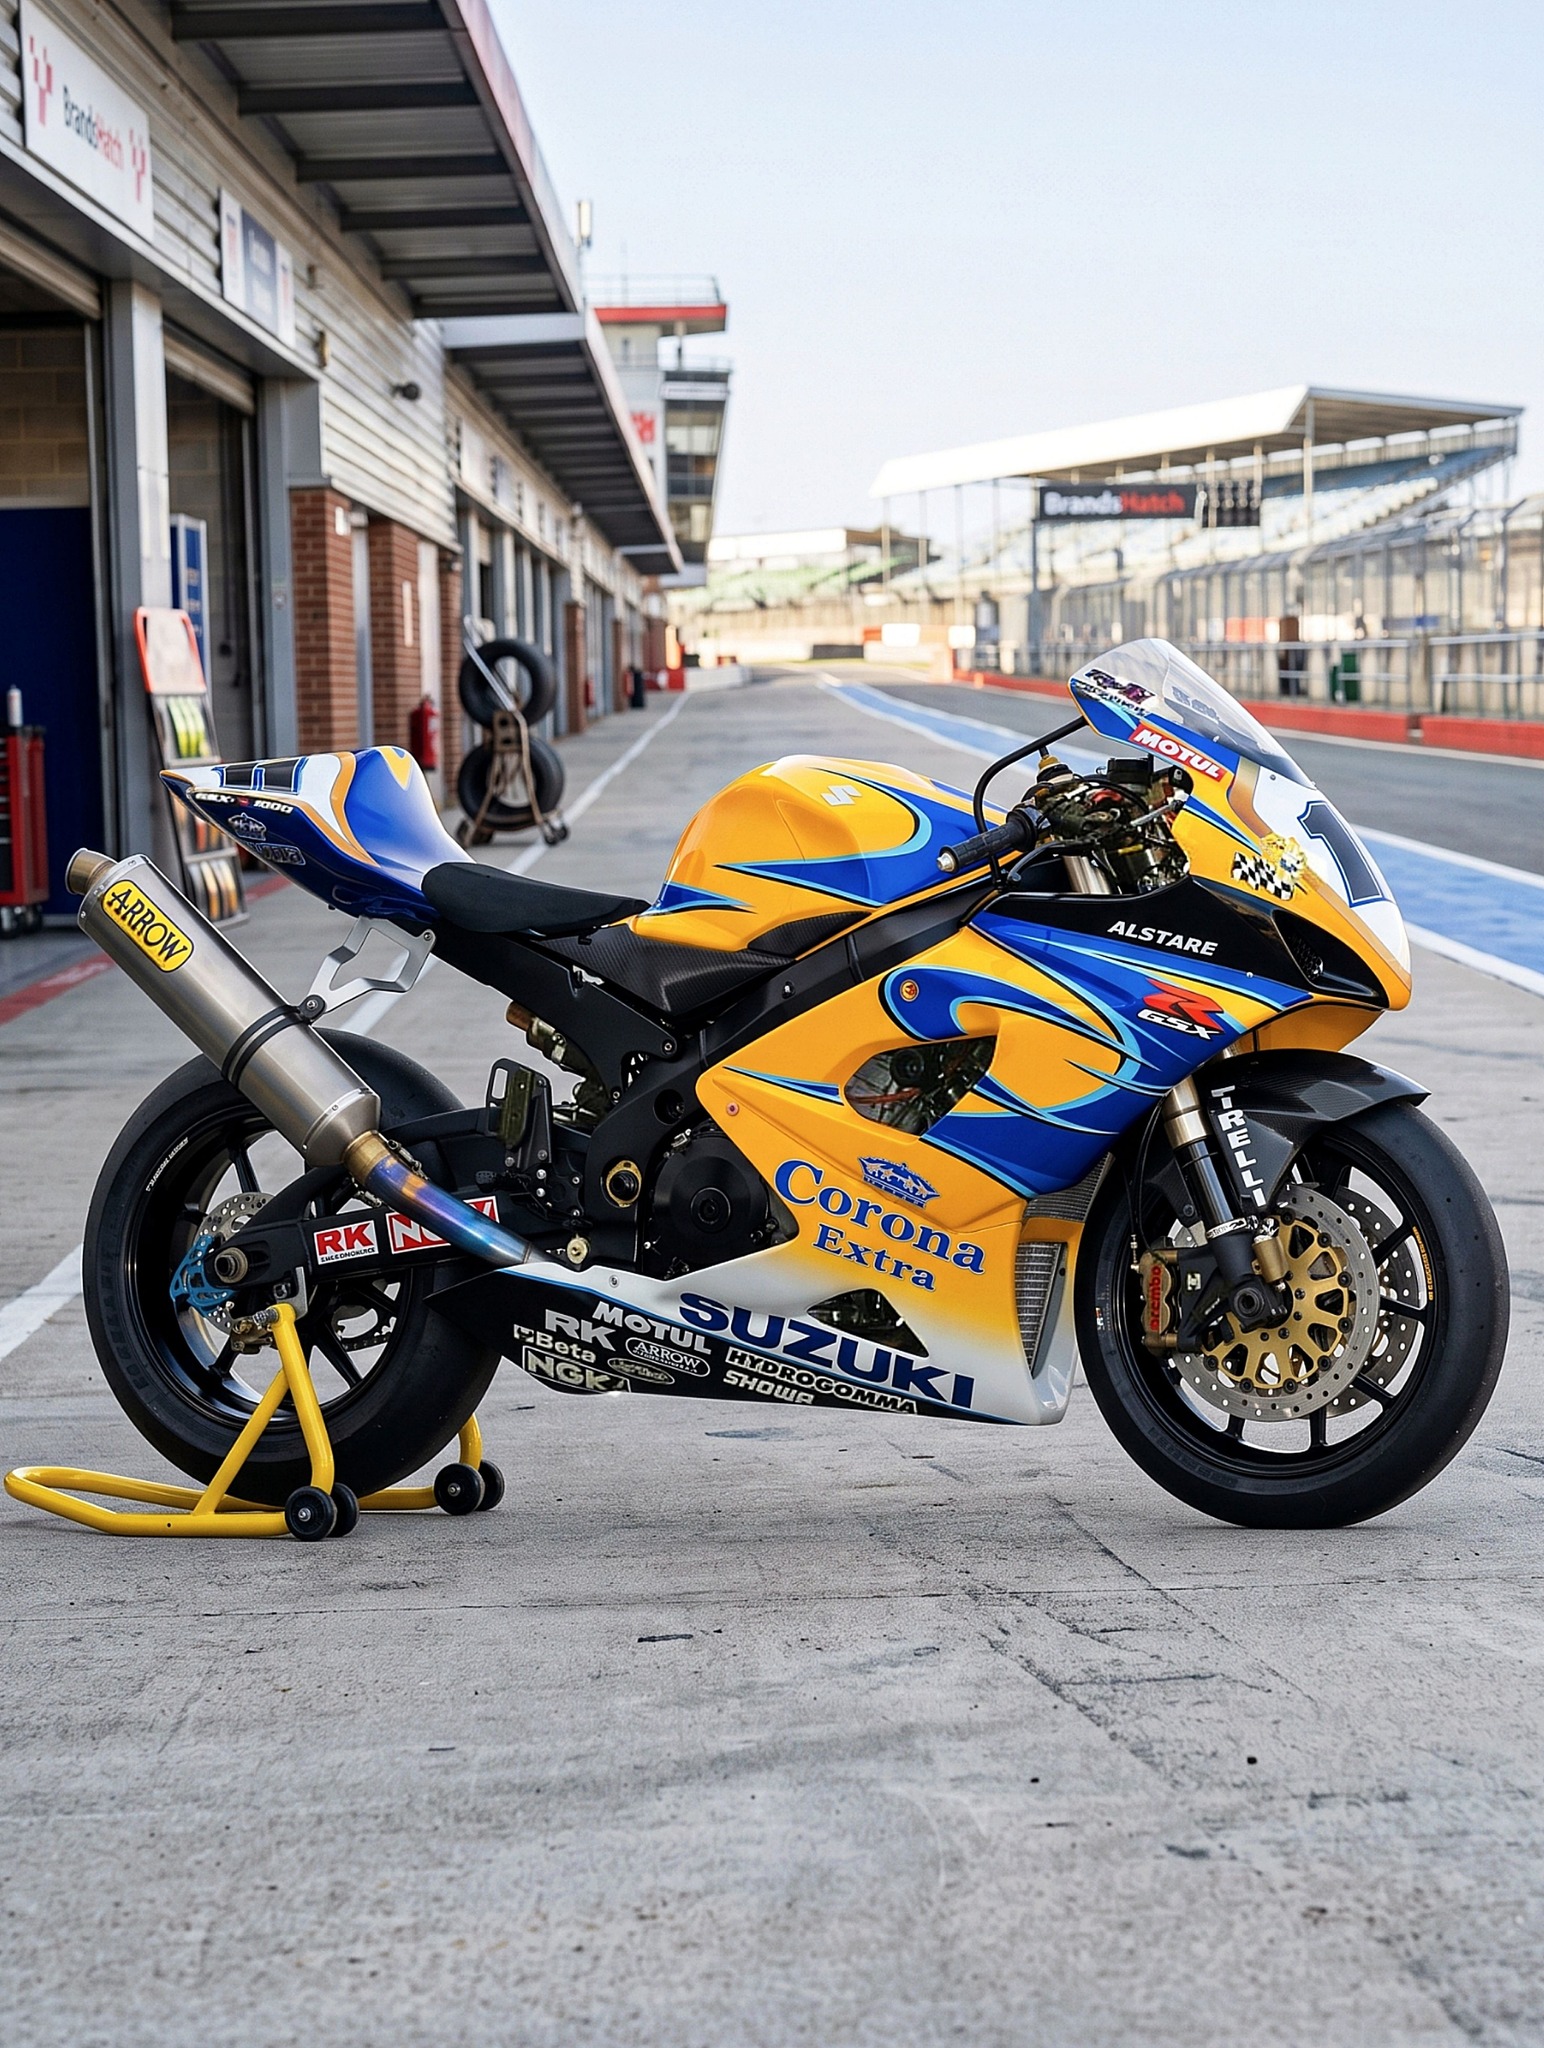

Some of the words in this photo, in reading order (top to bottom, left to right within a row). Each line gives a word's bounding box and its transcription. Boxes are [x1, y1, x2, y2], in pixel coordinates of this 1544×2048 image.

[1134, 730, 1220, 778] MOTUL
[1297, 801, 1385, 908] 1
[107, 888, 188, 962] ARROW
[1107, 920, 1218, 956] ALSTARE
[1137, 1008, 1220, 1040] GSX
[774, 1159, 985, 1275] Corona
[316, 1223, 374, 1257] RK
[813, 1223, 936, 1291] Extra
[536, 1333, 597, 1363] Beta
[545, 1309, 617, 1352] RK
[592, 1301, 712, 1355] MOTUL
[679, 1292, 975, 1409] SUZUKI
[527, 1350, 611, 1391] NGK
[632, 1342, 701, 1369] ARROW
[723, 1369, 815, 1404] SHOWA
[724, 1347, 918, 1414] HYDROGOMMA
